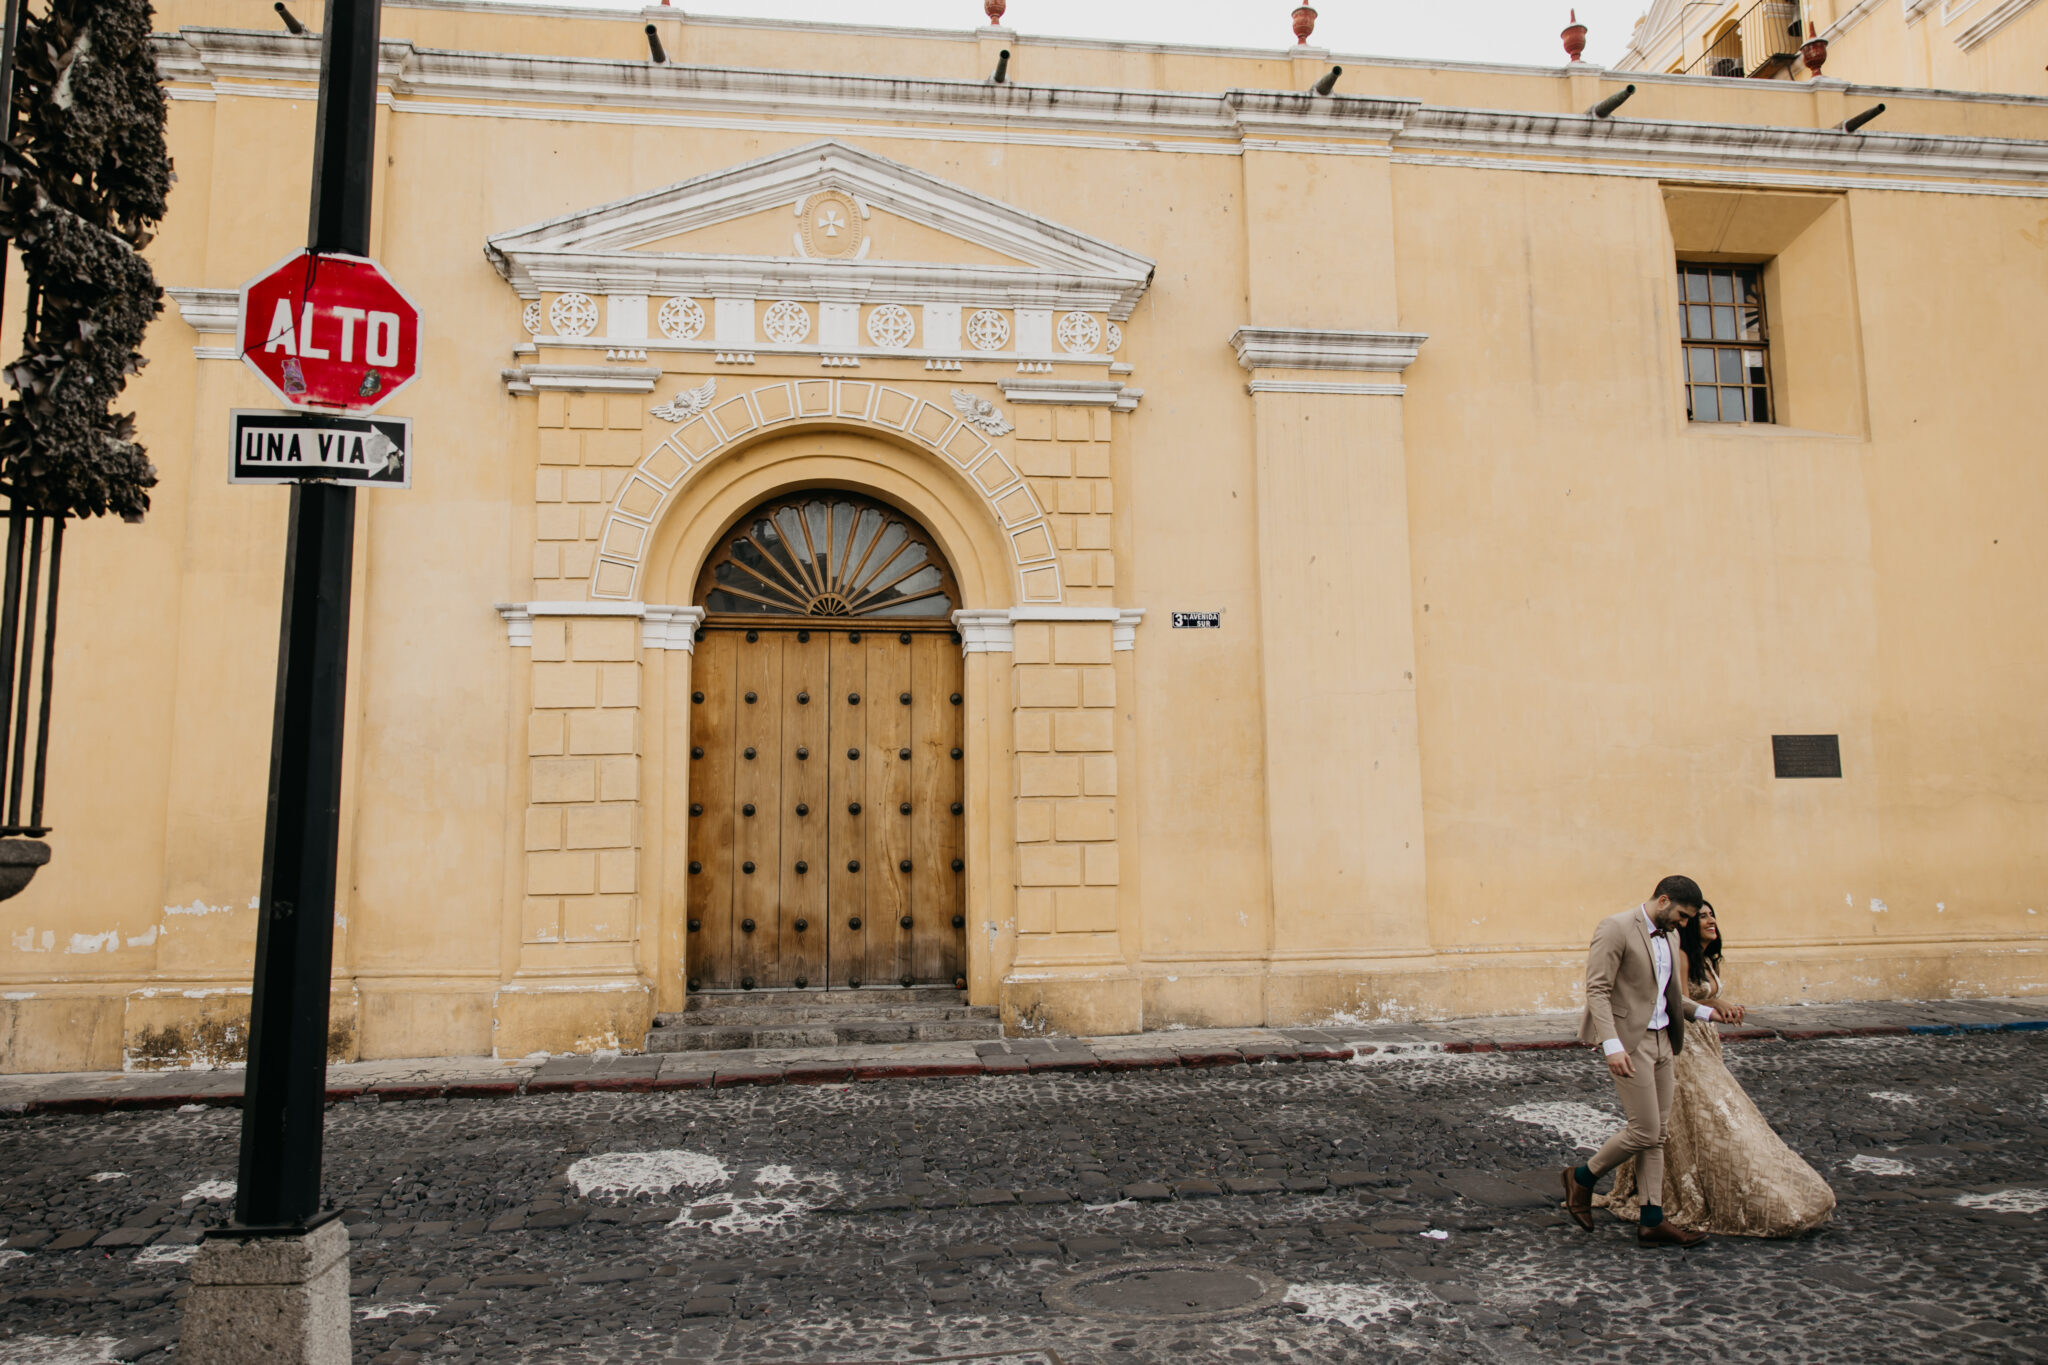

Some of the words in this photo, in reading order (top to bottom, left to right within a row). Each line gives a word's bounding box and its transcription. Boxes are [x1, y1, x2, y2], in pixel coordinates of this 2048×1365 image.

[264, 298, 400, 367] ALTO
[246, 432, 302, 462] UNA
[318, 433, 365, 464] VIA
